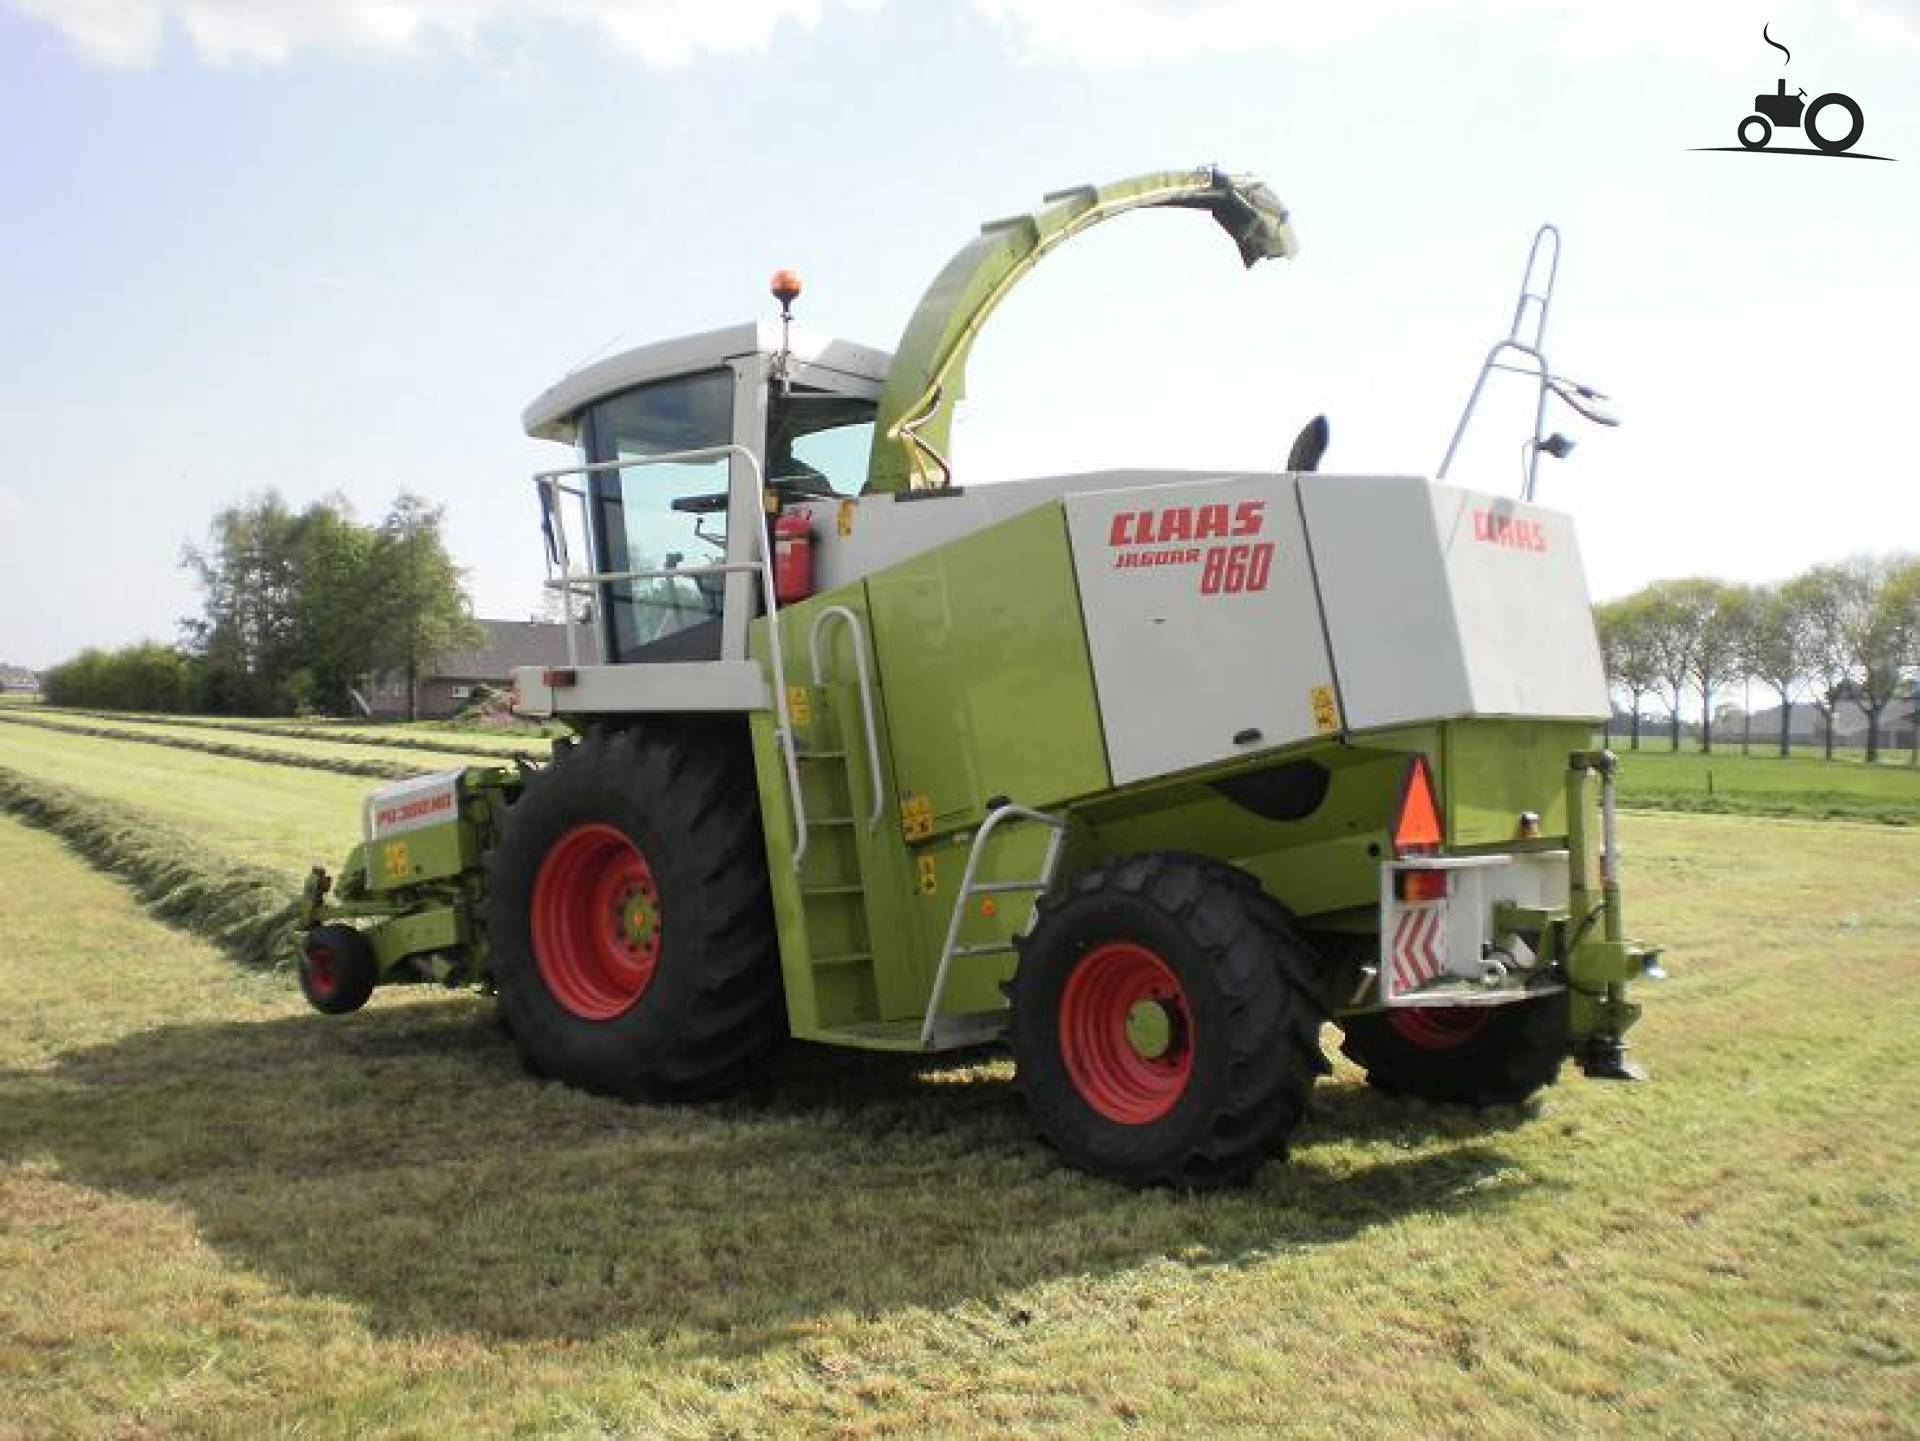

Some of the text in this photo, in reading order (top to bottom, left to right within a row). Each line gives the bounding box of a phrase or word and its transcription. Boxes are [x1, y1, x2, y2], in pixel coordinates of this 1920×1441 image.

[1109, 501, 1265, 546] CLAAS
[1114, 543, 1275, 595] JAGUAR 860
